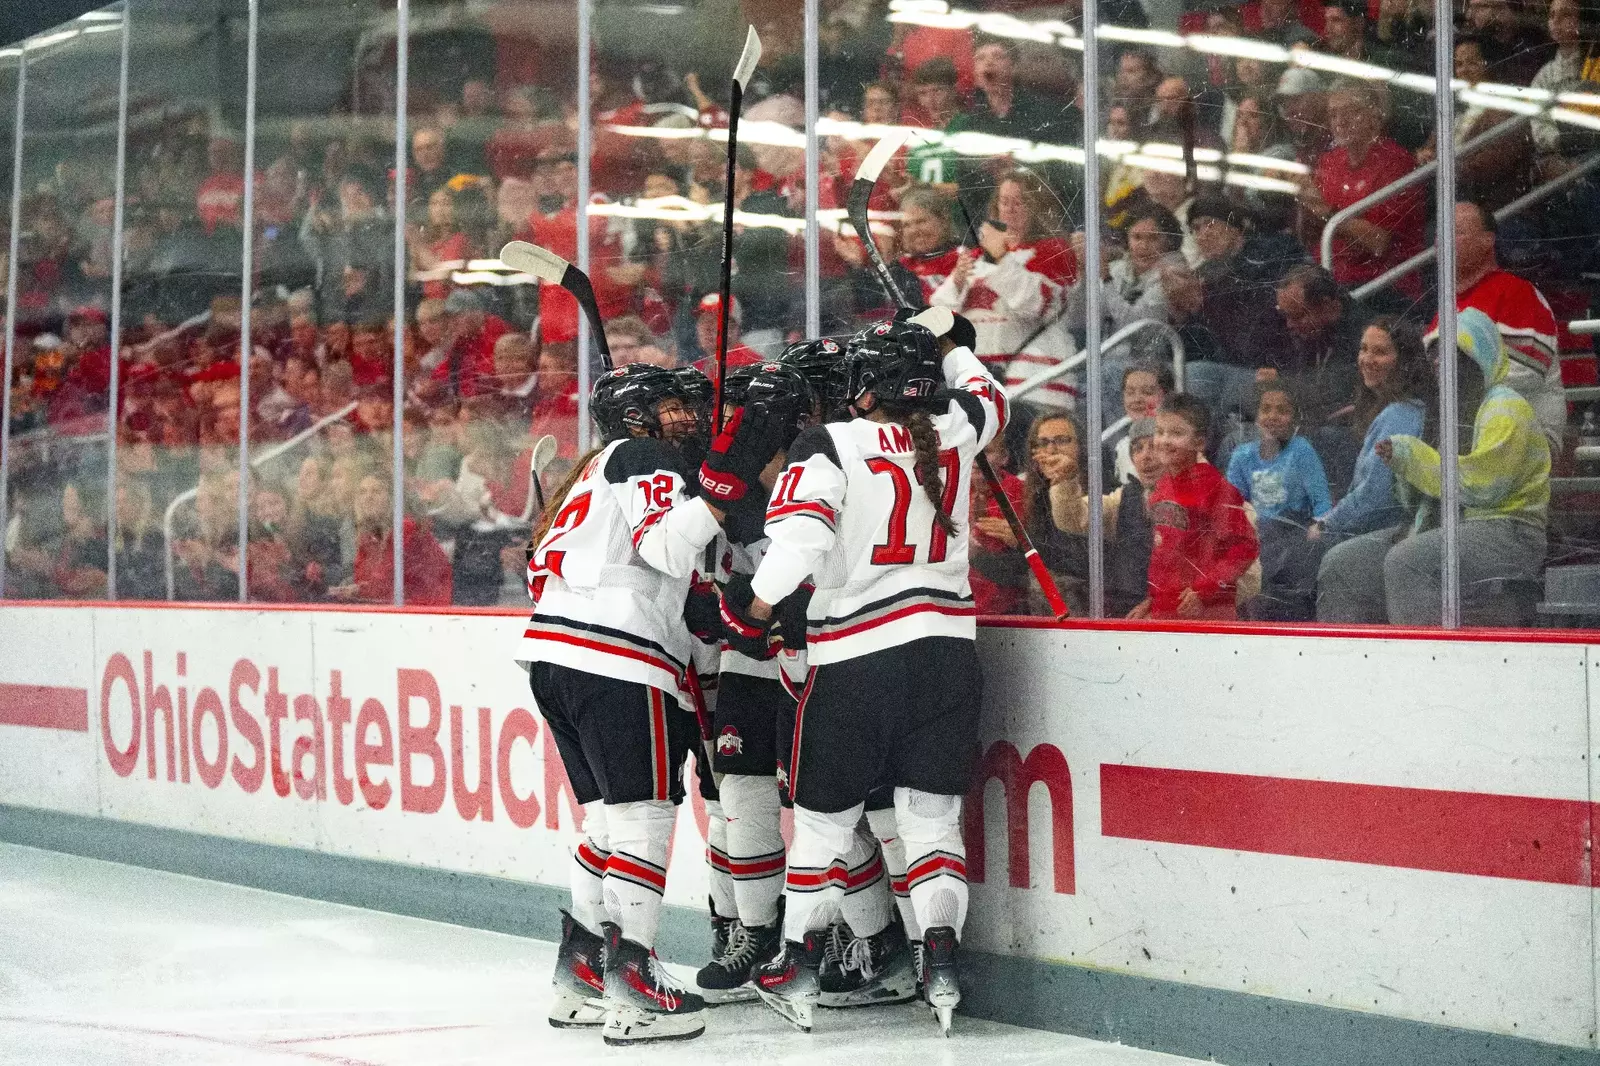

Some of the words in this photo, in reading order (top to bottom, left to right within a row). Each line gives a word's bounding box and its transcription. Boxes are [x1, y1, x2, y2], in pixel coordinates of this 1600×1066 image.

[918, 380, 931, 397] 17
[638, 474, 673, 513] 12
[770, 466, 805, 507] 17
[864, 447, 960, 565] 17
